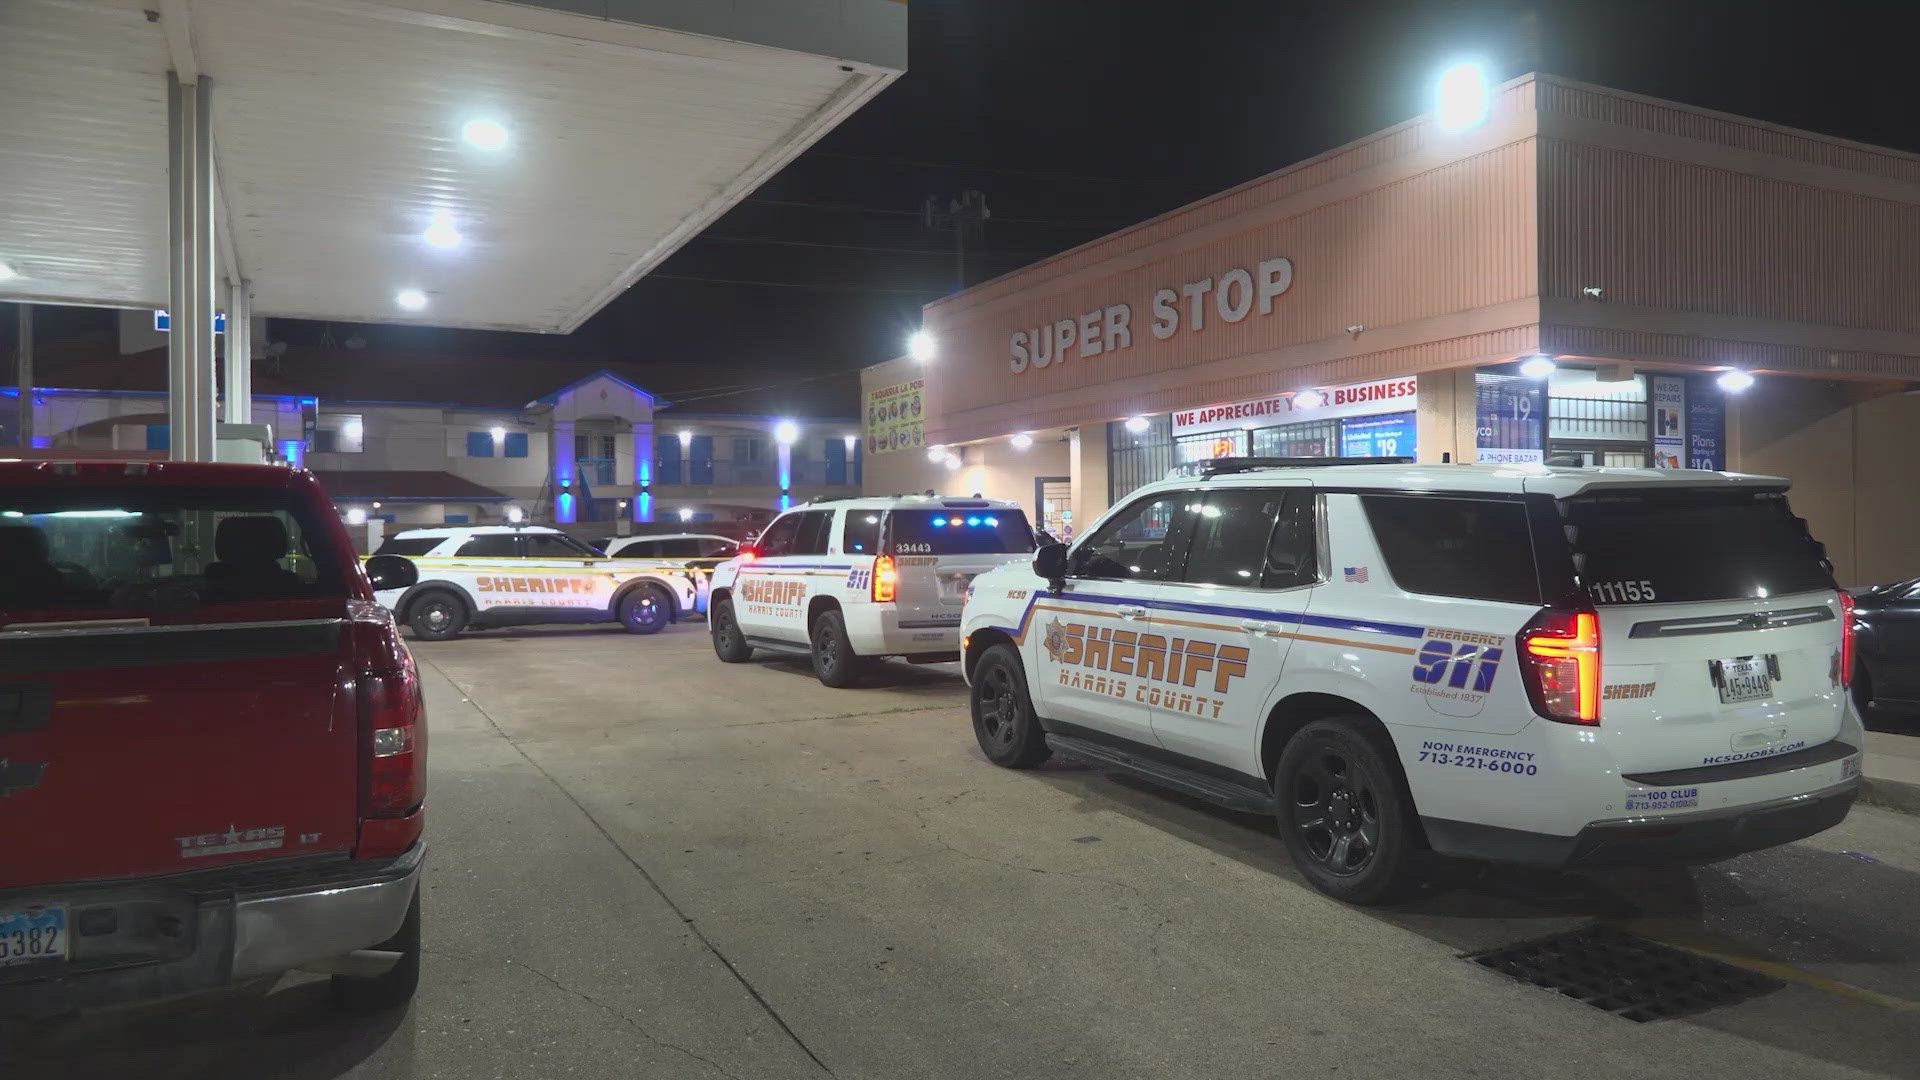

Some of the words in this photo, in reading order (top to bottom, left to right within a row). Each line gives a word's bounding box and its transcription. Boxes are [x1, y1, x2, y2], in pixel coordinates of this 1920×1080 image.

[1010, 303, 1131, 374] SUPER
[1152, 257, 1292, 339] STOP
[871, 386, 899, 400] TAQUERIA
[900, 383, 908, 392] LA
[1656, 384, 1668, 392] WE
[1669, 384, 1679, 392] DO
[1176, 412, 1195, 426] WE
[1199, 400, 1280, 423] APPRECIATE
[1285, 391, 1329, 412] YR
[1335, 380, 1416, 405] BUSINESS
[1655, 393, 1681, 402] REPAIRS
[1508, 395, 1530, 421] $19
[1692, 434, 1715, 447] Plans
[1487, 454, 1512, 463] PHONE
[1515, 455, 1538, 463] BAZAR
[896, 543, 931, 553] 33443
[898, 557, 938, 567] SHERIFF
[476, 576, 582, 593] SHERIFF
[847, 570, 870, 590] 911
[746, 579, 807, 606] SHERIFF
[1007, 590, 1027, 600] HCSO
[1593, 580, 1656, 602] 11155
[748, 605, 773, 616] HARRIS
[775, 607, 803, 619] COUNTY
[1427, 628, 1506, 646] EMERGENCY
[1063, 623, 1250, 694] SHERIFF
[1412, 640, 1503, 693] 911
[1733, 664, 1753, 673] TEXAS
[1059, 669, 1127, 698] HARRIS
[1135, 685, 1224, 719] COUNTY
[1410, 685, 1457, 700] Established
[1460, 693, 1483, 703] 1837
[1602, 682, 1656, 700] SHERIFF
[1423, 741, 1453, 752] NON
[1457, 745, 1535, 762] EMERGENCY
[1703, 741, 1805, 765] HCSOJOBS.COM
[1418, 751, 1538, 776] 713-221-6000
[1648, 791, 1667, 800] 100
[1671, 788, 1698, 799] CLUB
[1635, 799, 1687, 810] 713-952-0100
[301, 832, 323, 844] LT
